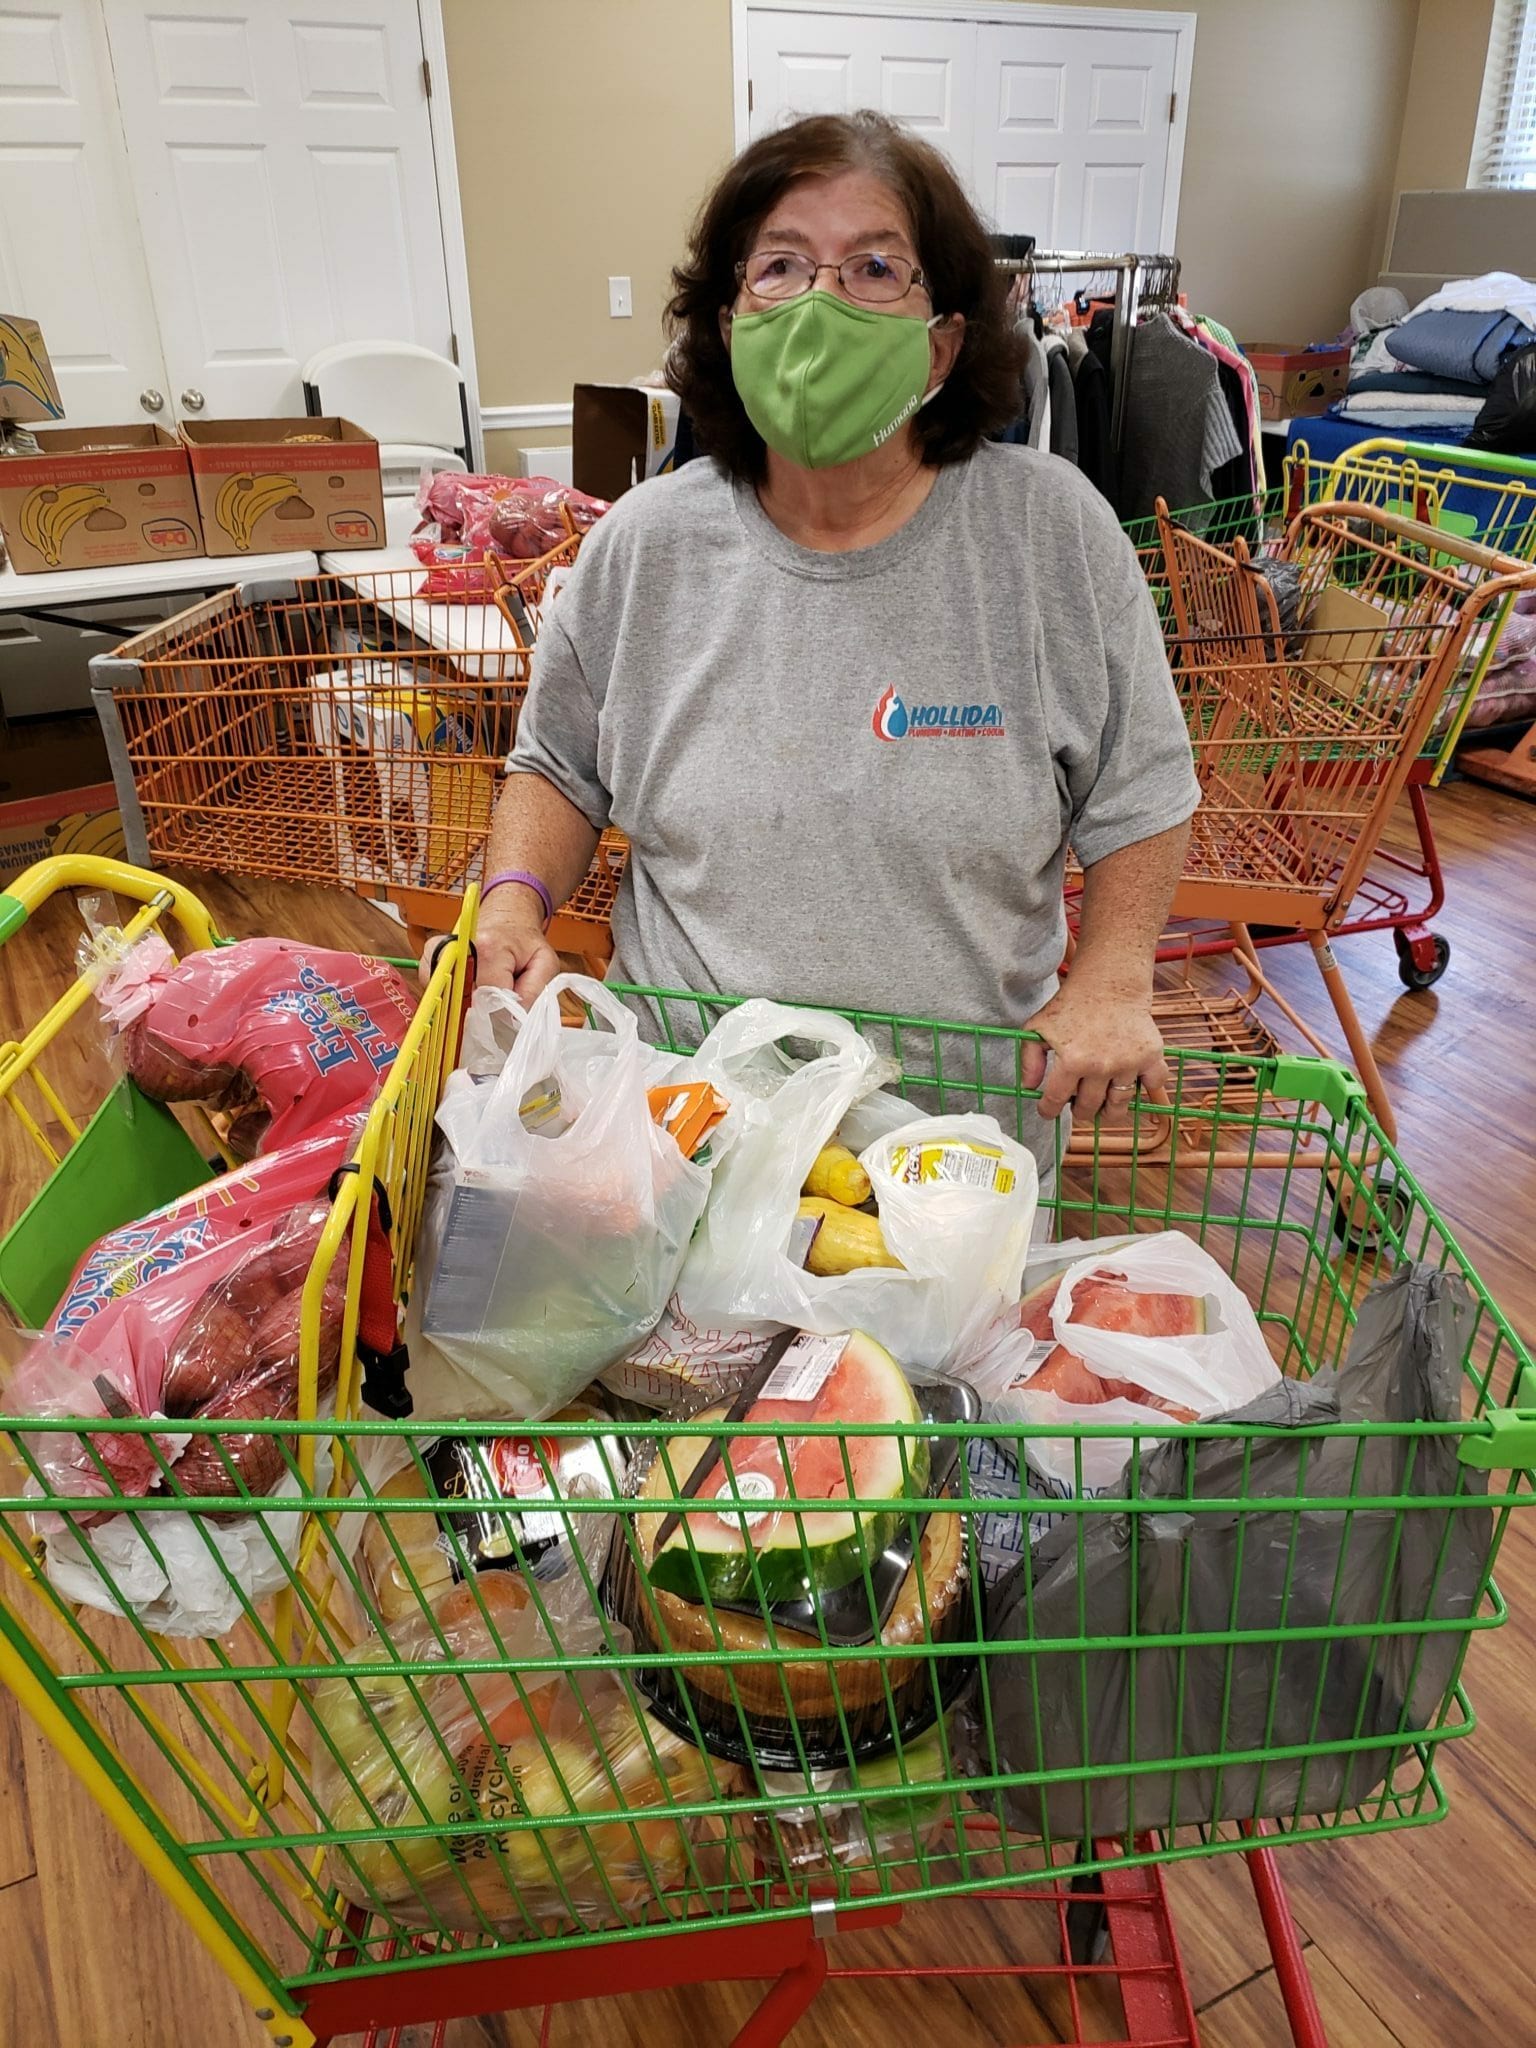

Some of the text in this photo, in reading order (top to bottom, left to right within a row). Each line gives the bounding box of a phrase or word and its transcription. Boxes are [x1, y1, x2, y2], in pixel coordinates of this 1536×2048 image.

[872, 394, 918, 448] Humana
[151, 530, 187, 547] Dole
[335, 523, 369, 538] Dole
